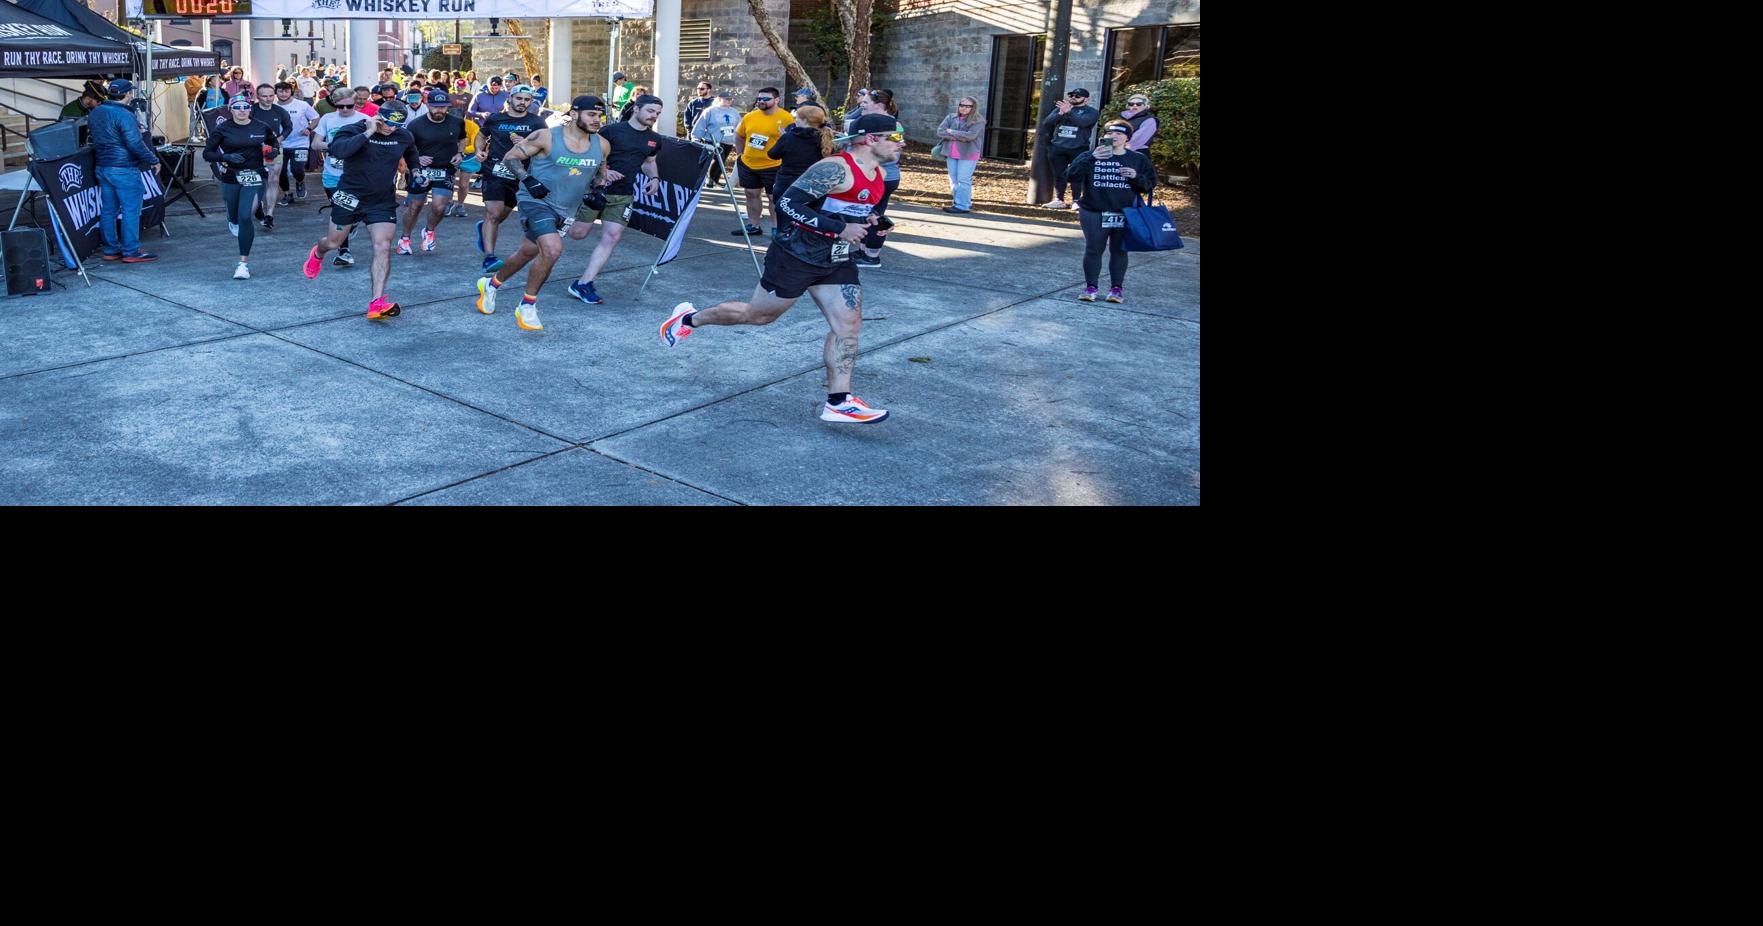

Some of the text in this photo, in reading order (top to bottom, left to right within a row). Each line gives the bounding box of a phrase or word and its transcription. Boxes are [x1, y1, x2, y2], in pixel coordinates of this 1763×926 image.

[346, 0, 430, 12] WHISKEY
[438, 0, 475, 12] RUN
[4, 51, 129, 65] RUN THY RACE. DRINK THY WHISKEY.
[159, 59, 168, 69] THY
[181, 58, 192, 67] DRINK
[192, 57, 200, 67] THY
[556, 156, 598, 167] RUNATL
[60, 167, 80, 186] THE
[1093, 181, 1131, 189] Galactic
[335, 193, 353, 205] 225
[63, 185, 103, 231] WHISK
[780, 197, 808, 223] Reebok
